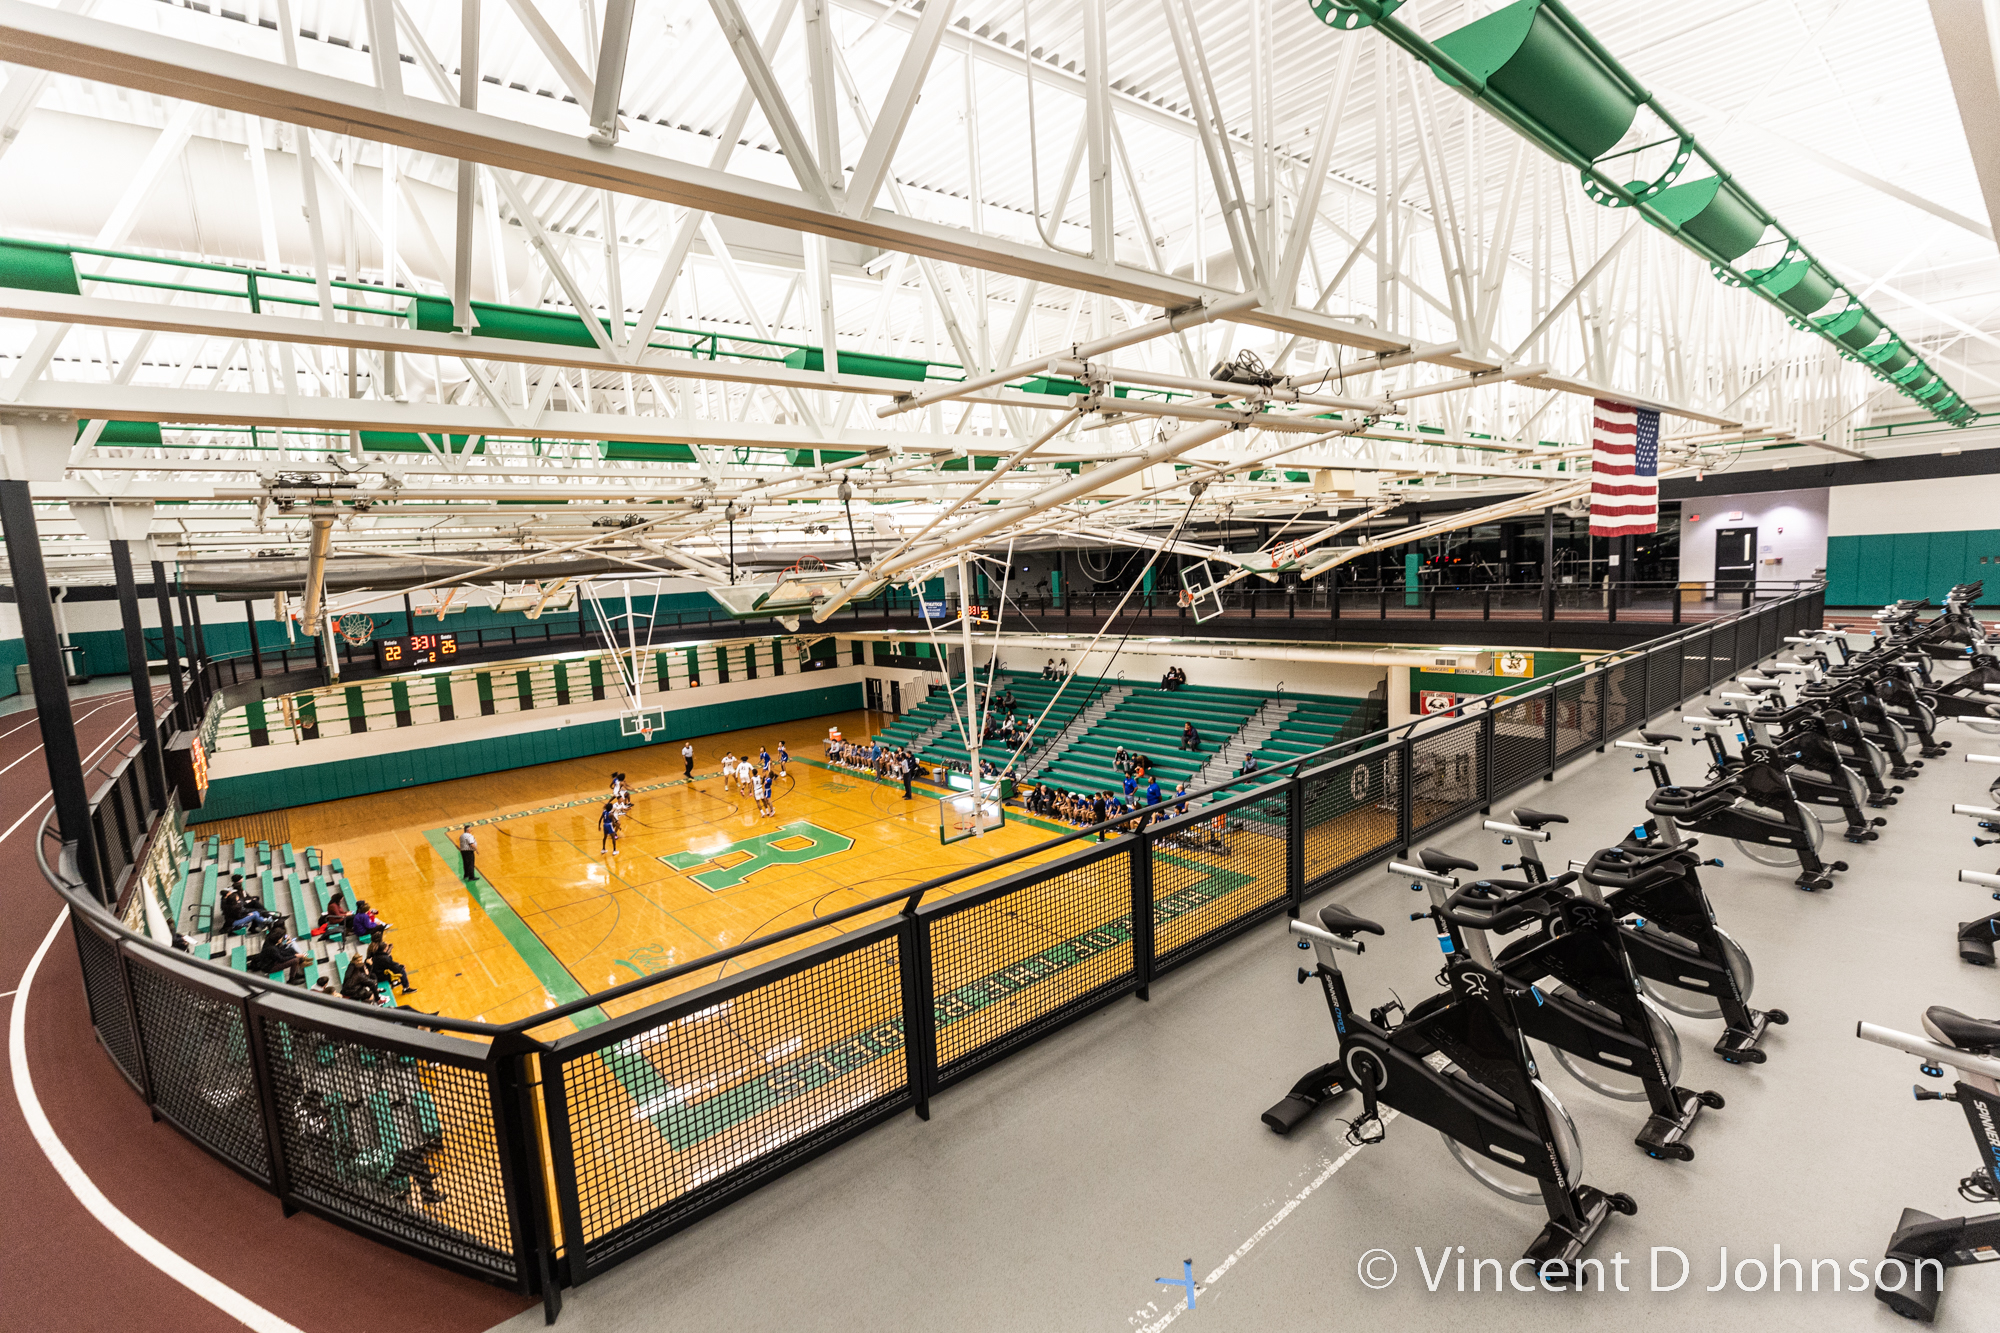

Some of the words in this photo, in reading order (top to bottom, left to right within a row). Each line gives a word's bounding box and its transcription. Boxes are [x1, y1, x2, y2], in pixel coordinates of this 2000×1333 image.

[385, 646, 402, 661] 22
[410, 635, 436, 651] 3:31
[441, 640, 457, 654] 25
[890, 641, 902, 655] R
[429, 652, 436, 662] 2
[657, 821, 854, 891] R
[1325, 974, 1339, 1007] SPINNER
[1649, 1047, 1668, 1088] SPINNING
[1974, 1100, 2000, 1147] SPINNER
[1544, 1140, 1565, 1189] SPINNING
